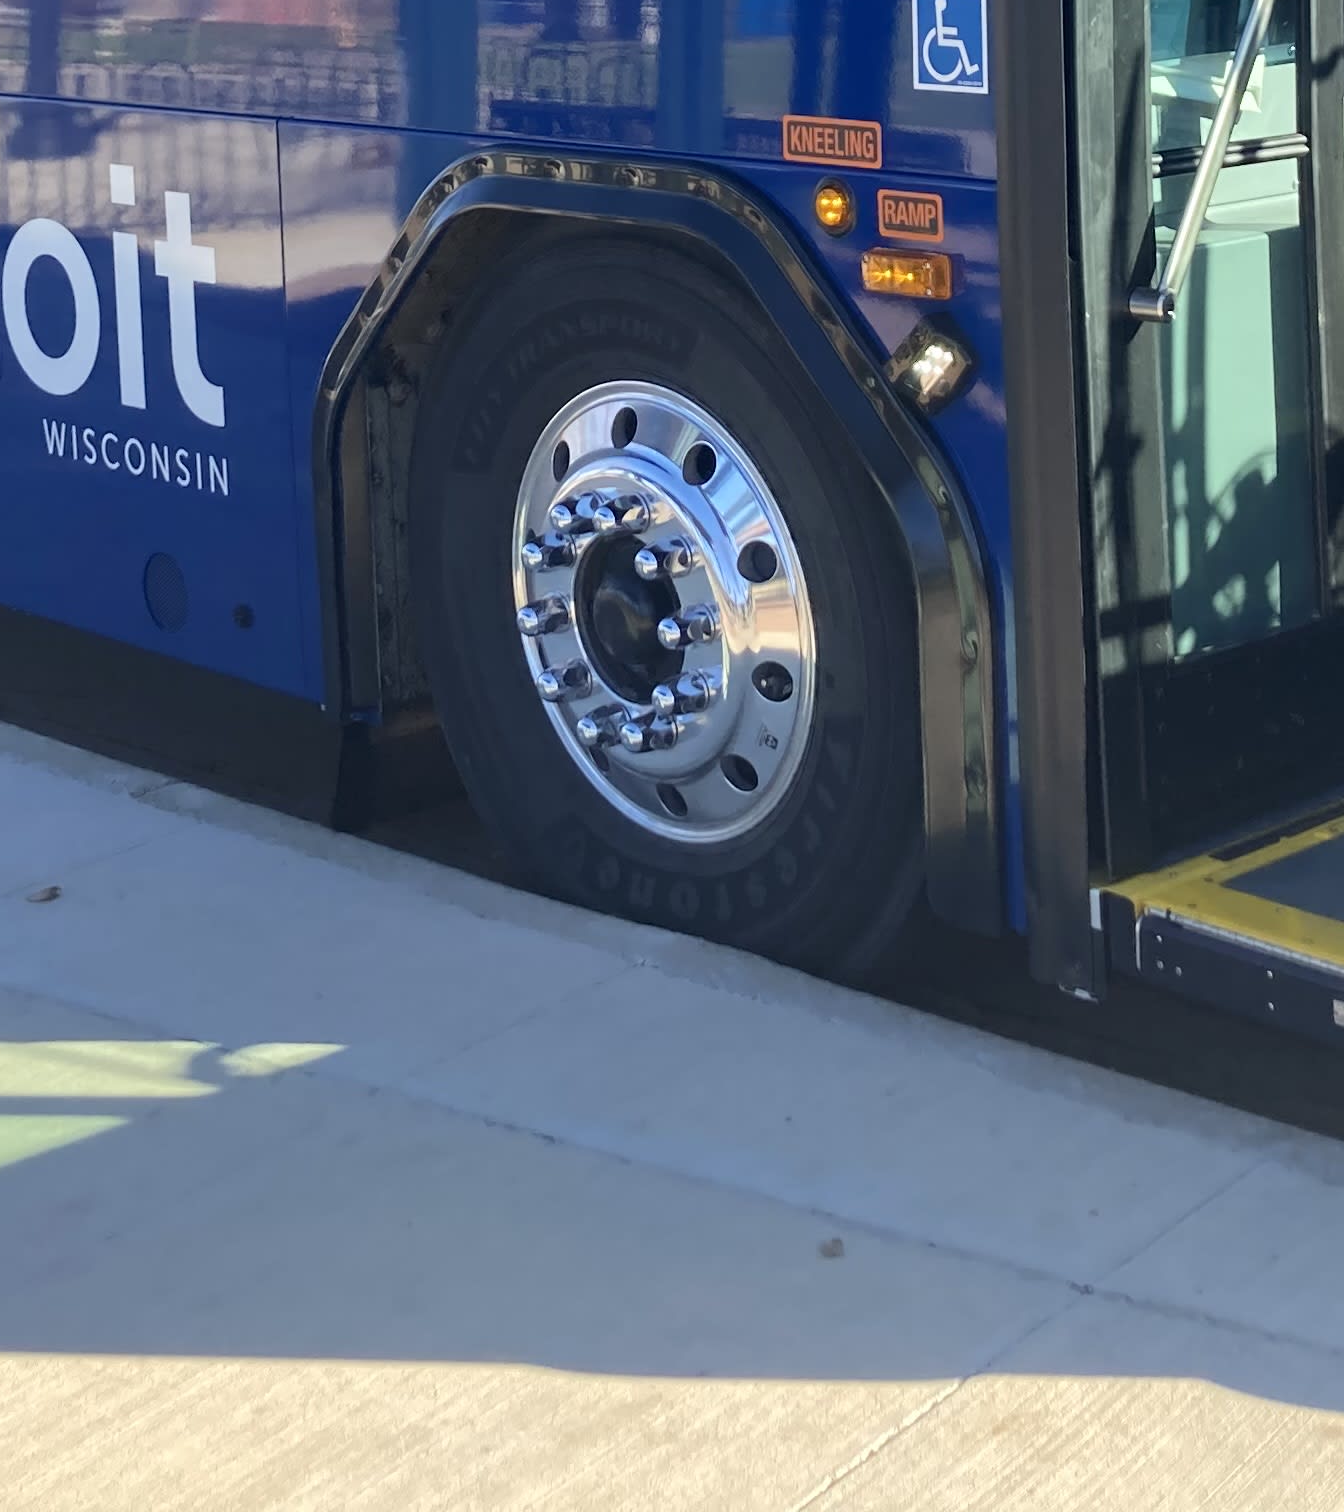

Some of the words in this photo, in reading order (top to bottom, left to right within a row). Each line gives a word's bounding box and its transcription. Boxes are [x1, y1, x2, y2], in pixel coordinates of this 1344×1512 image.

[789, 125, 874, 159] KNEELING
[882, 198, 936, 226] RAMP
[42, 417, 230, 497] WISCONSIN
